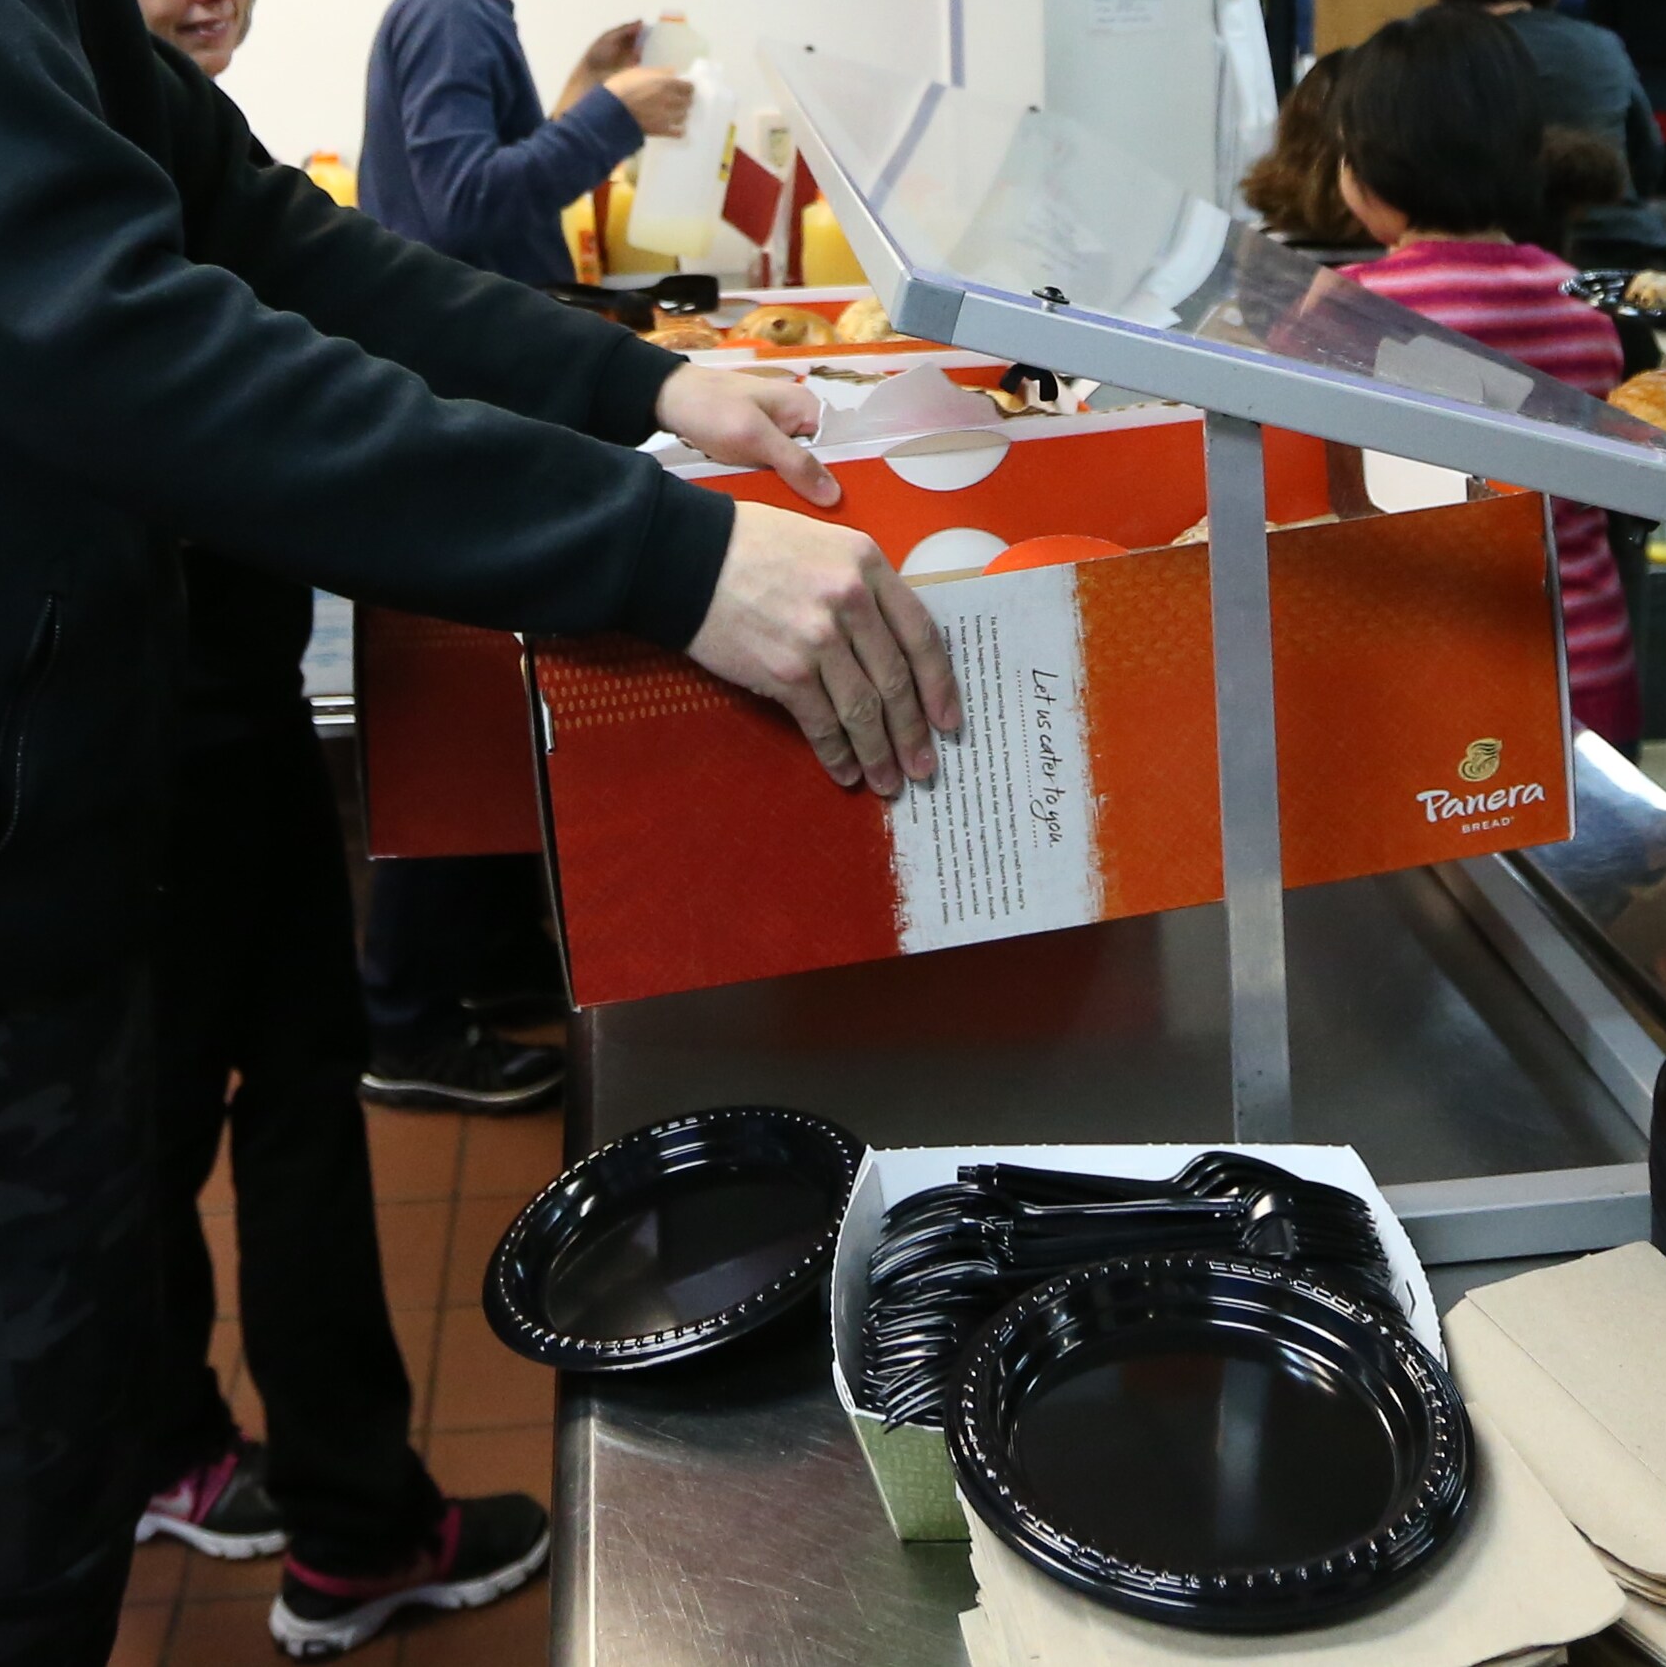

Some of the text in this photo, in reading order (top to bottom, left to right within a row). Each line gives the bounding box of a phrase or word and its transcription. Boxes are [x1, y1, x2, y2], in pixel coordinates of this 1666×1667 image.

[965, 682, 973, 702] work
[968, 705, 974, 713] of
[991, 616, 997, 626] In
[997, 683, 1005, 719] morning
[1003, 751, 1011, 782] Panera
[1009, 814, 1017, 838] begin
[1029, 667, 1066, 849] Let us cater to you.
[990, 772, 996, 783] As
[1416, 783, 1545, 822] Panera
[1461, 816, 1511, 834] BREAD
